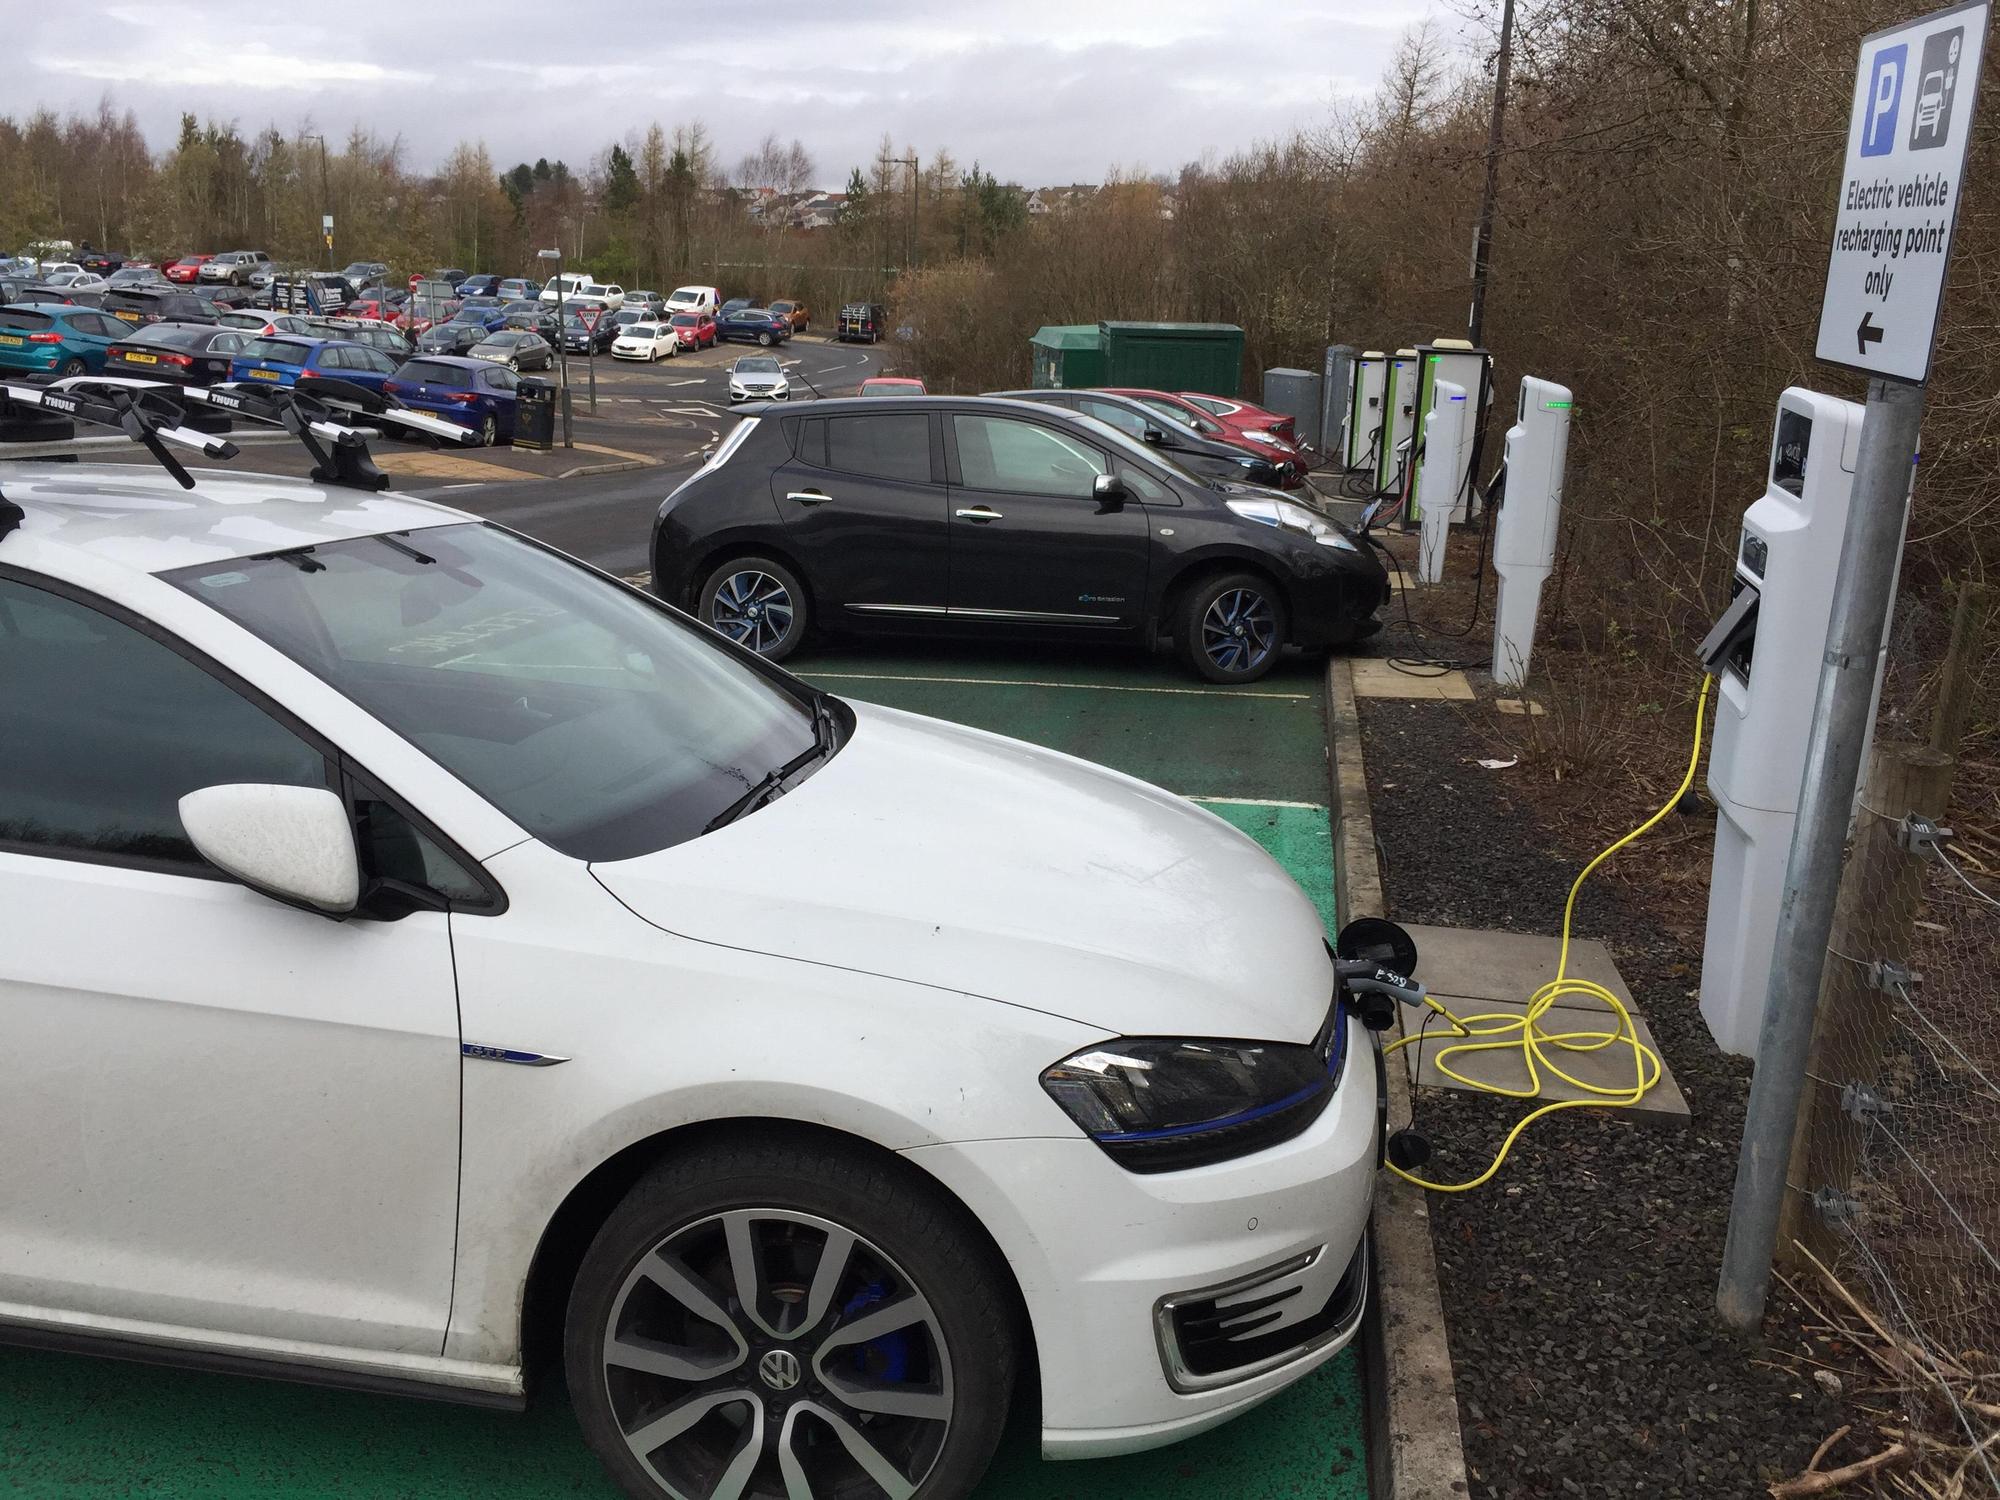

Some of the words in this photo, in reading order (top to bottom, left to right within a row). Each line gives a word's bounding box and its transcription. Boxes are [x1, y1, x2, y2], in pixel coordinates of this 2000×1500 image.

[1868, 62, 1898, 146] P
[1846, 177, 1894, 210] Electric
[1898, 172, 1948, 208] vehicle
[1837, 220, 1902, 258] recharging
[1904, 219, 1945, 259] point
[1865, 263, 1893, 302] only
[45, 395, 76, 412] THULE
[211, 393, 240, 408] THULE
